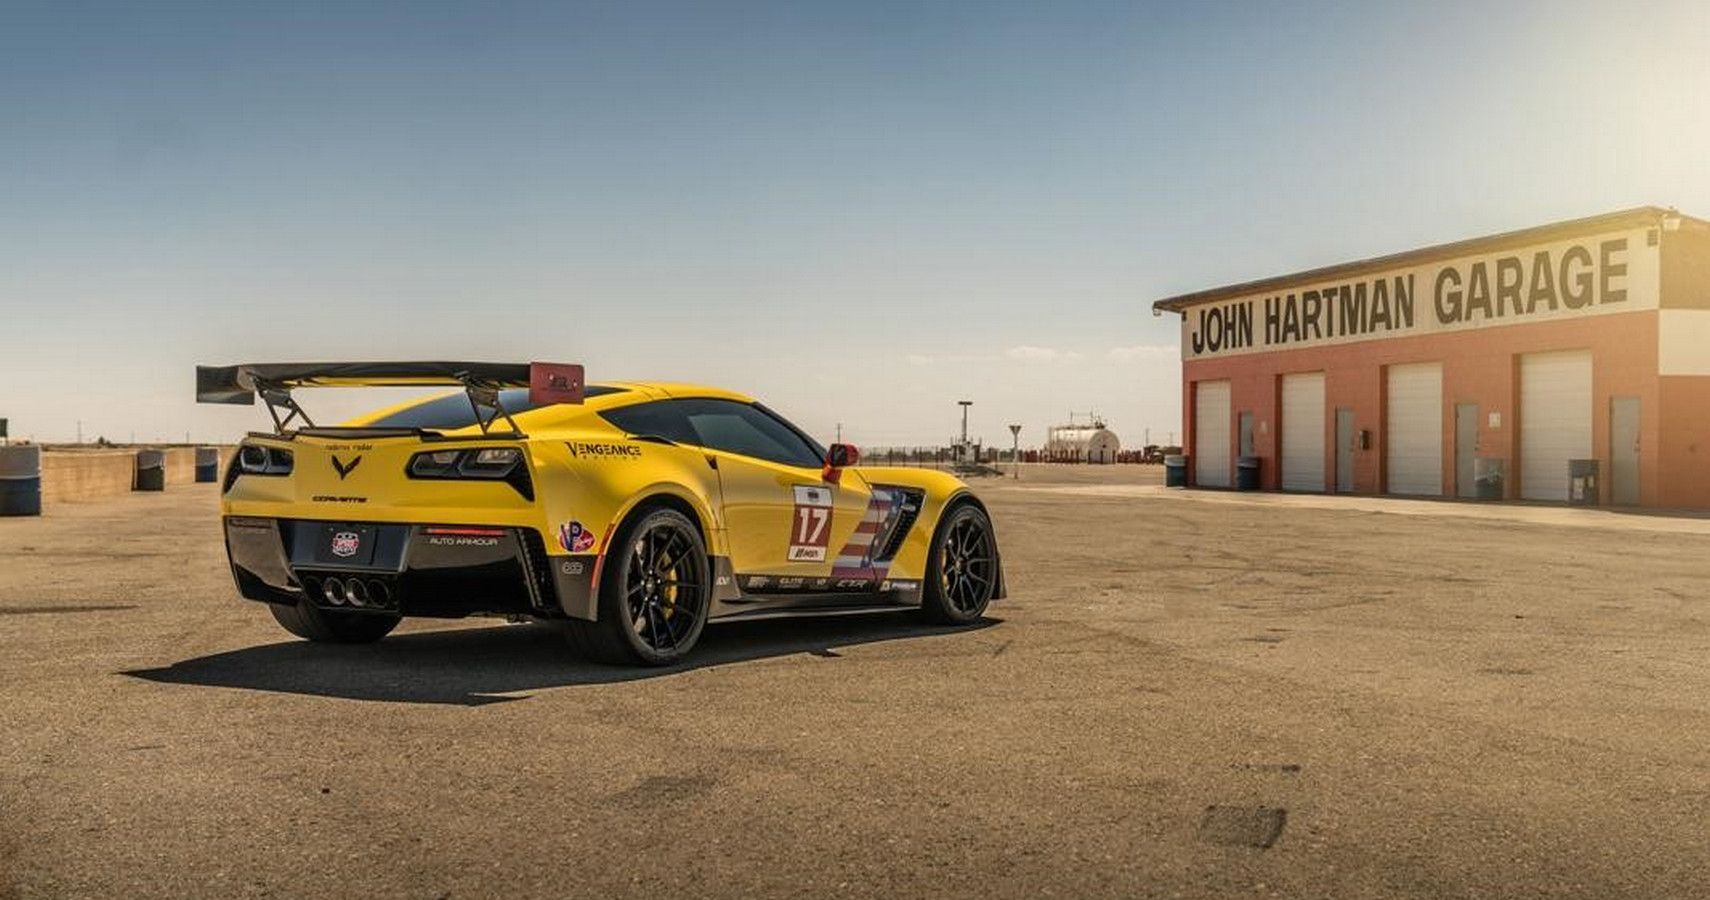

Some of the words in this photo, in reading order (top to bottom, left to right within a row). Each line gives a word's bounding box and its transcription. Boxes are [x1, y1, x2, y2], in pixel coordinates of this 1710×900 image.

[1192, 301, 1253, 355] JOHN
[1264, 273, 1415, 345] HARTMAN
[1434, 238, 1629, 325] GARAGE
[564, 441, 642, 458] VENGEANCE
[560, 521, 583, 552] VP
[799, 507, 829, 543] 17
[456, 538, 498, 546] ARMOUR
